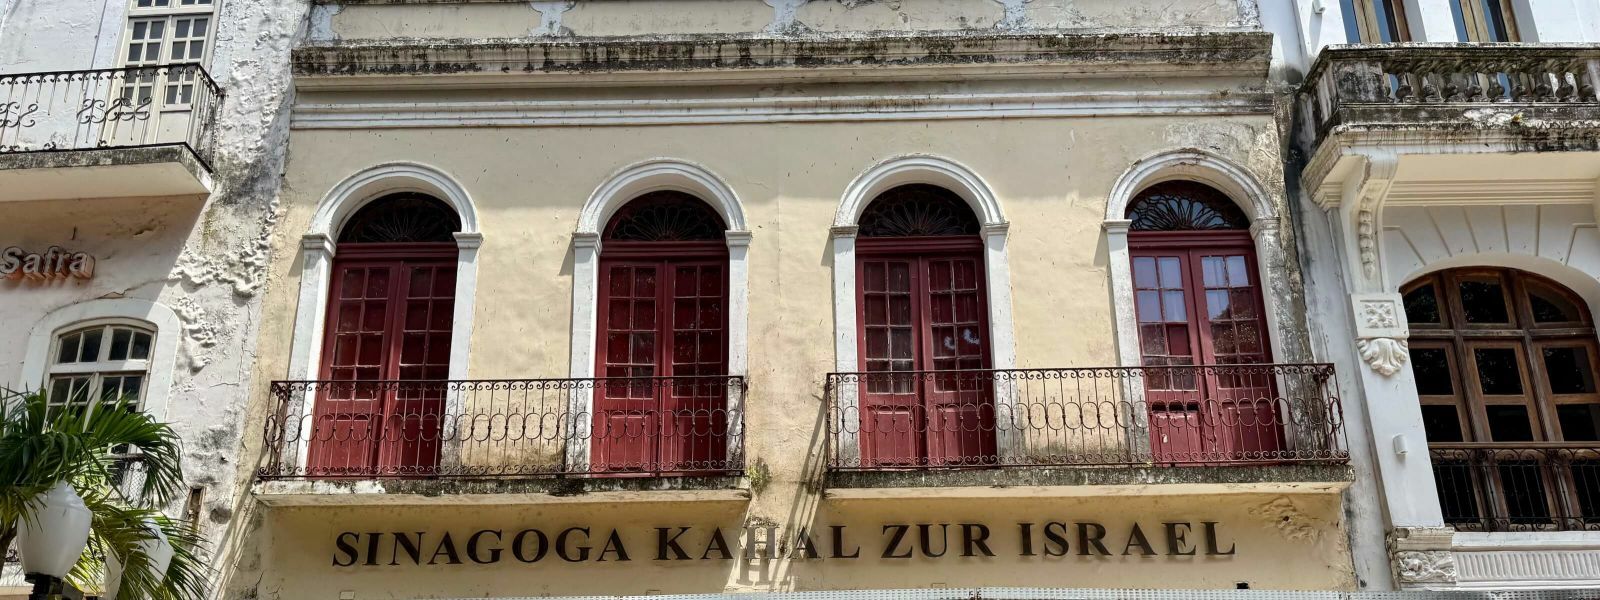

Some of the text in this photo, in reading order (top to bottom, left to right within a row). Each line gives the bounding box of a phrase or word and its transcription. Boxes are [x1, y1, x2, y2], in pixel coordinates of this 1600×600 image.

[0, 246, 93, 279] Safra
[332, 521, 1236, 567] SINAGOGA KAHAL ZUR ISRAEL
